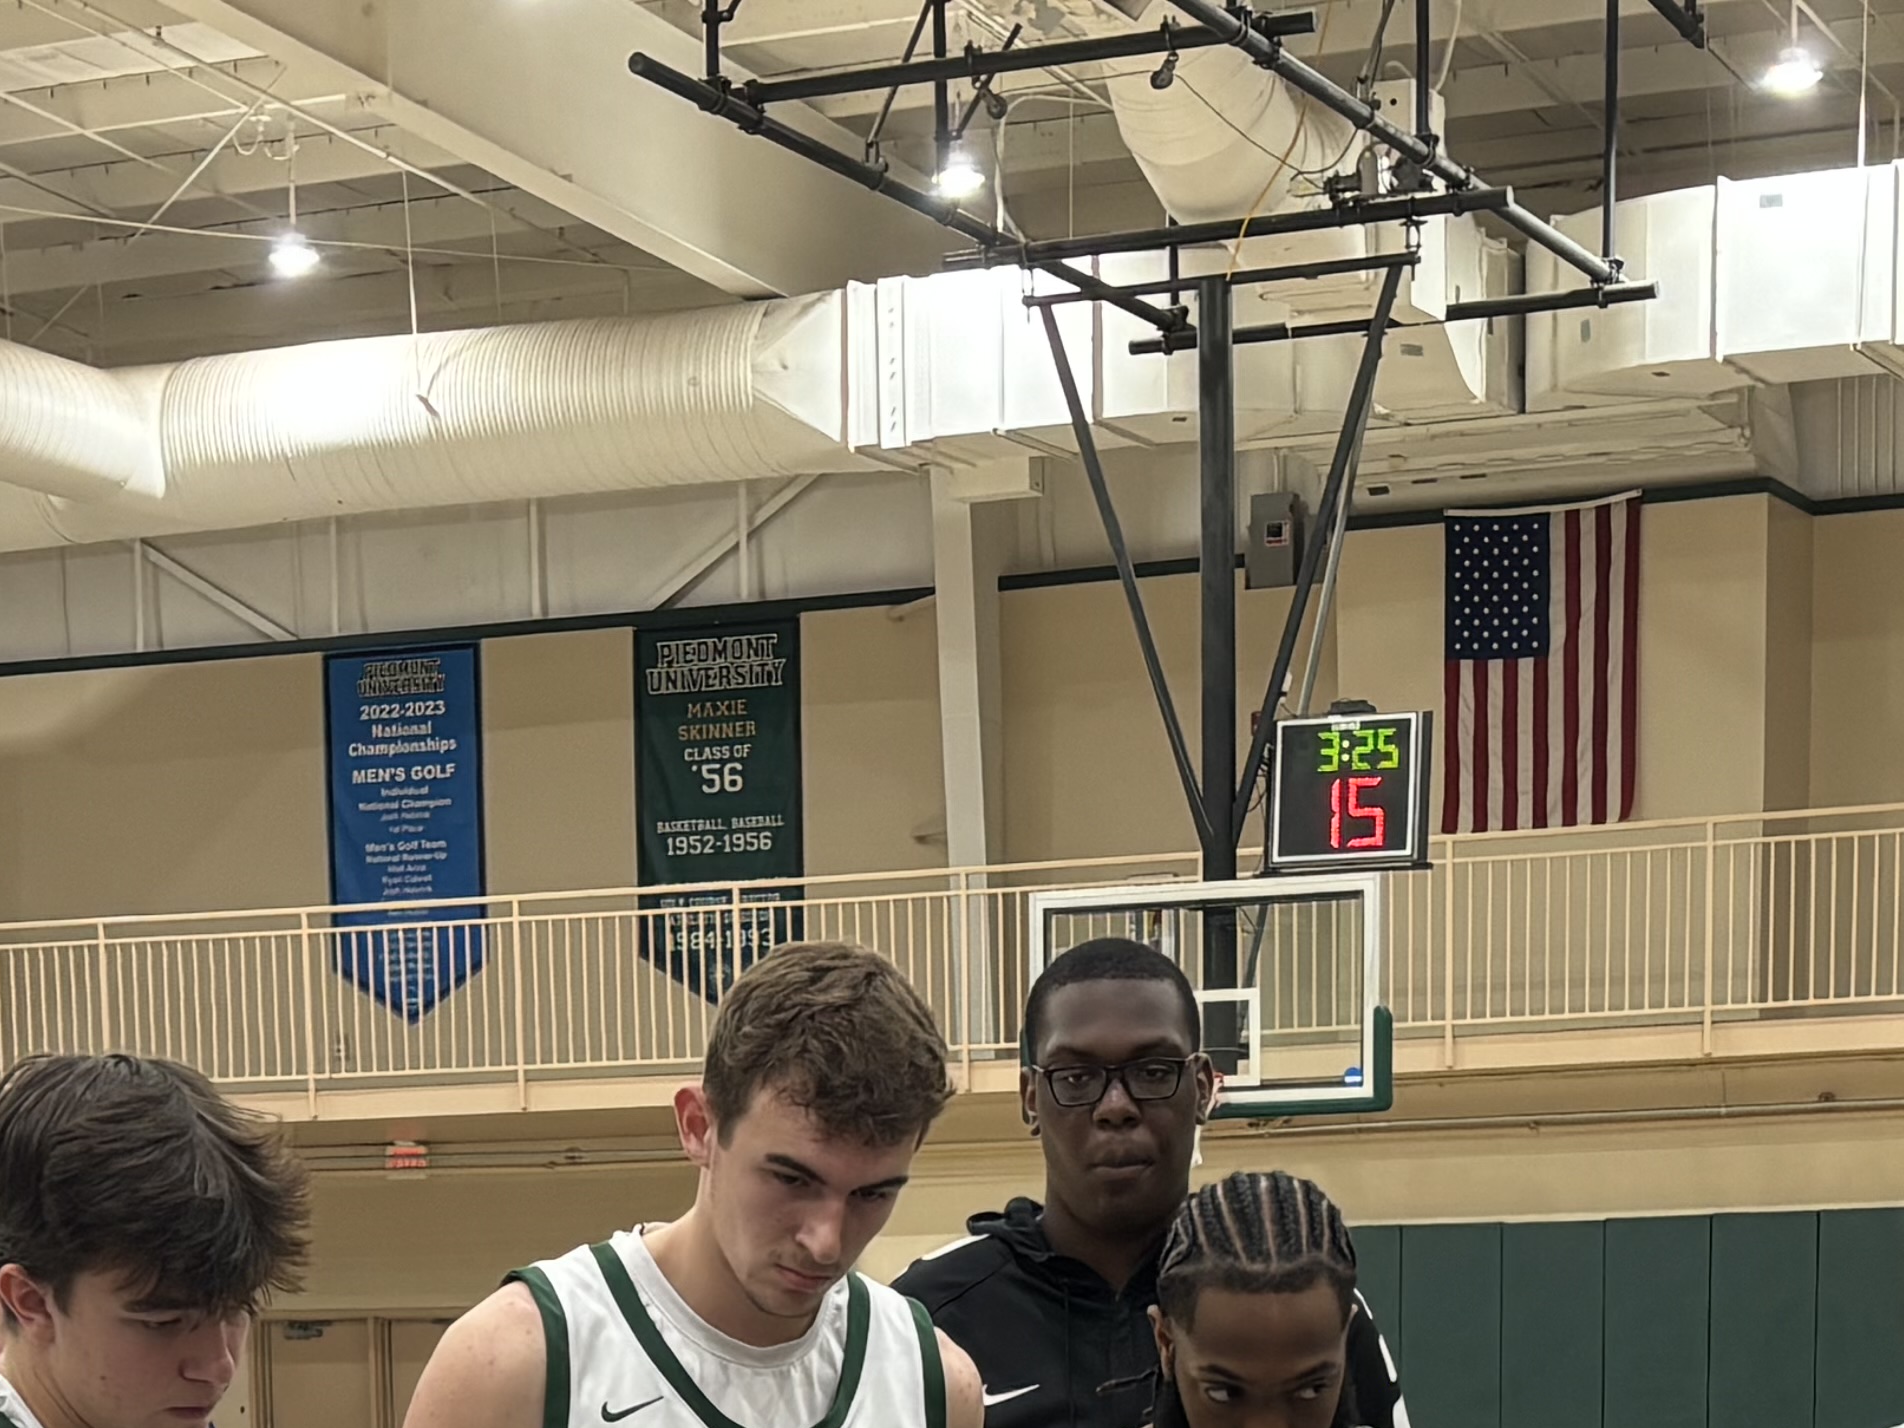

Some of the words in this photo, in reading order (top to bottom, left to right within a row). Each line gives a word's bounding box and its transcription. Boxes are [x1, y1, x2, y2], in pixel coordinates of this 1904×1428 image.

[657, 634, 778, 668] PIEDMONT
[646, 659, 786, 694] UNIVERSITY
[359, 700, 446, 720] 2022-2023
[688, 700, 747, 718] MAXIE
[371, 721, 432, 738] National
[678, 721, 756, 740] SKINNER
[348, 737, 457, 757] Championships
[684, 746, 730, 761] CLASS
[734, 744, 752, 758] OF
[1317, 728, 1399, 772] 3:25
[352, 767, 406, 784] MEN'S
[410, 763, 456, 781] GOLF
[691, 762, 743, 793] '56
[731, 815, 784, 829] BASEBALL
[1330, 777, 1385, 849] 15
[667, 832, 772, 855] 1952-1956
